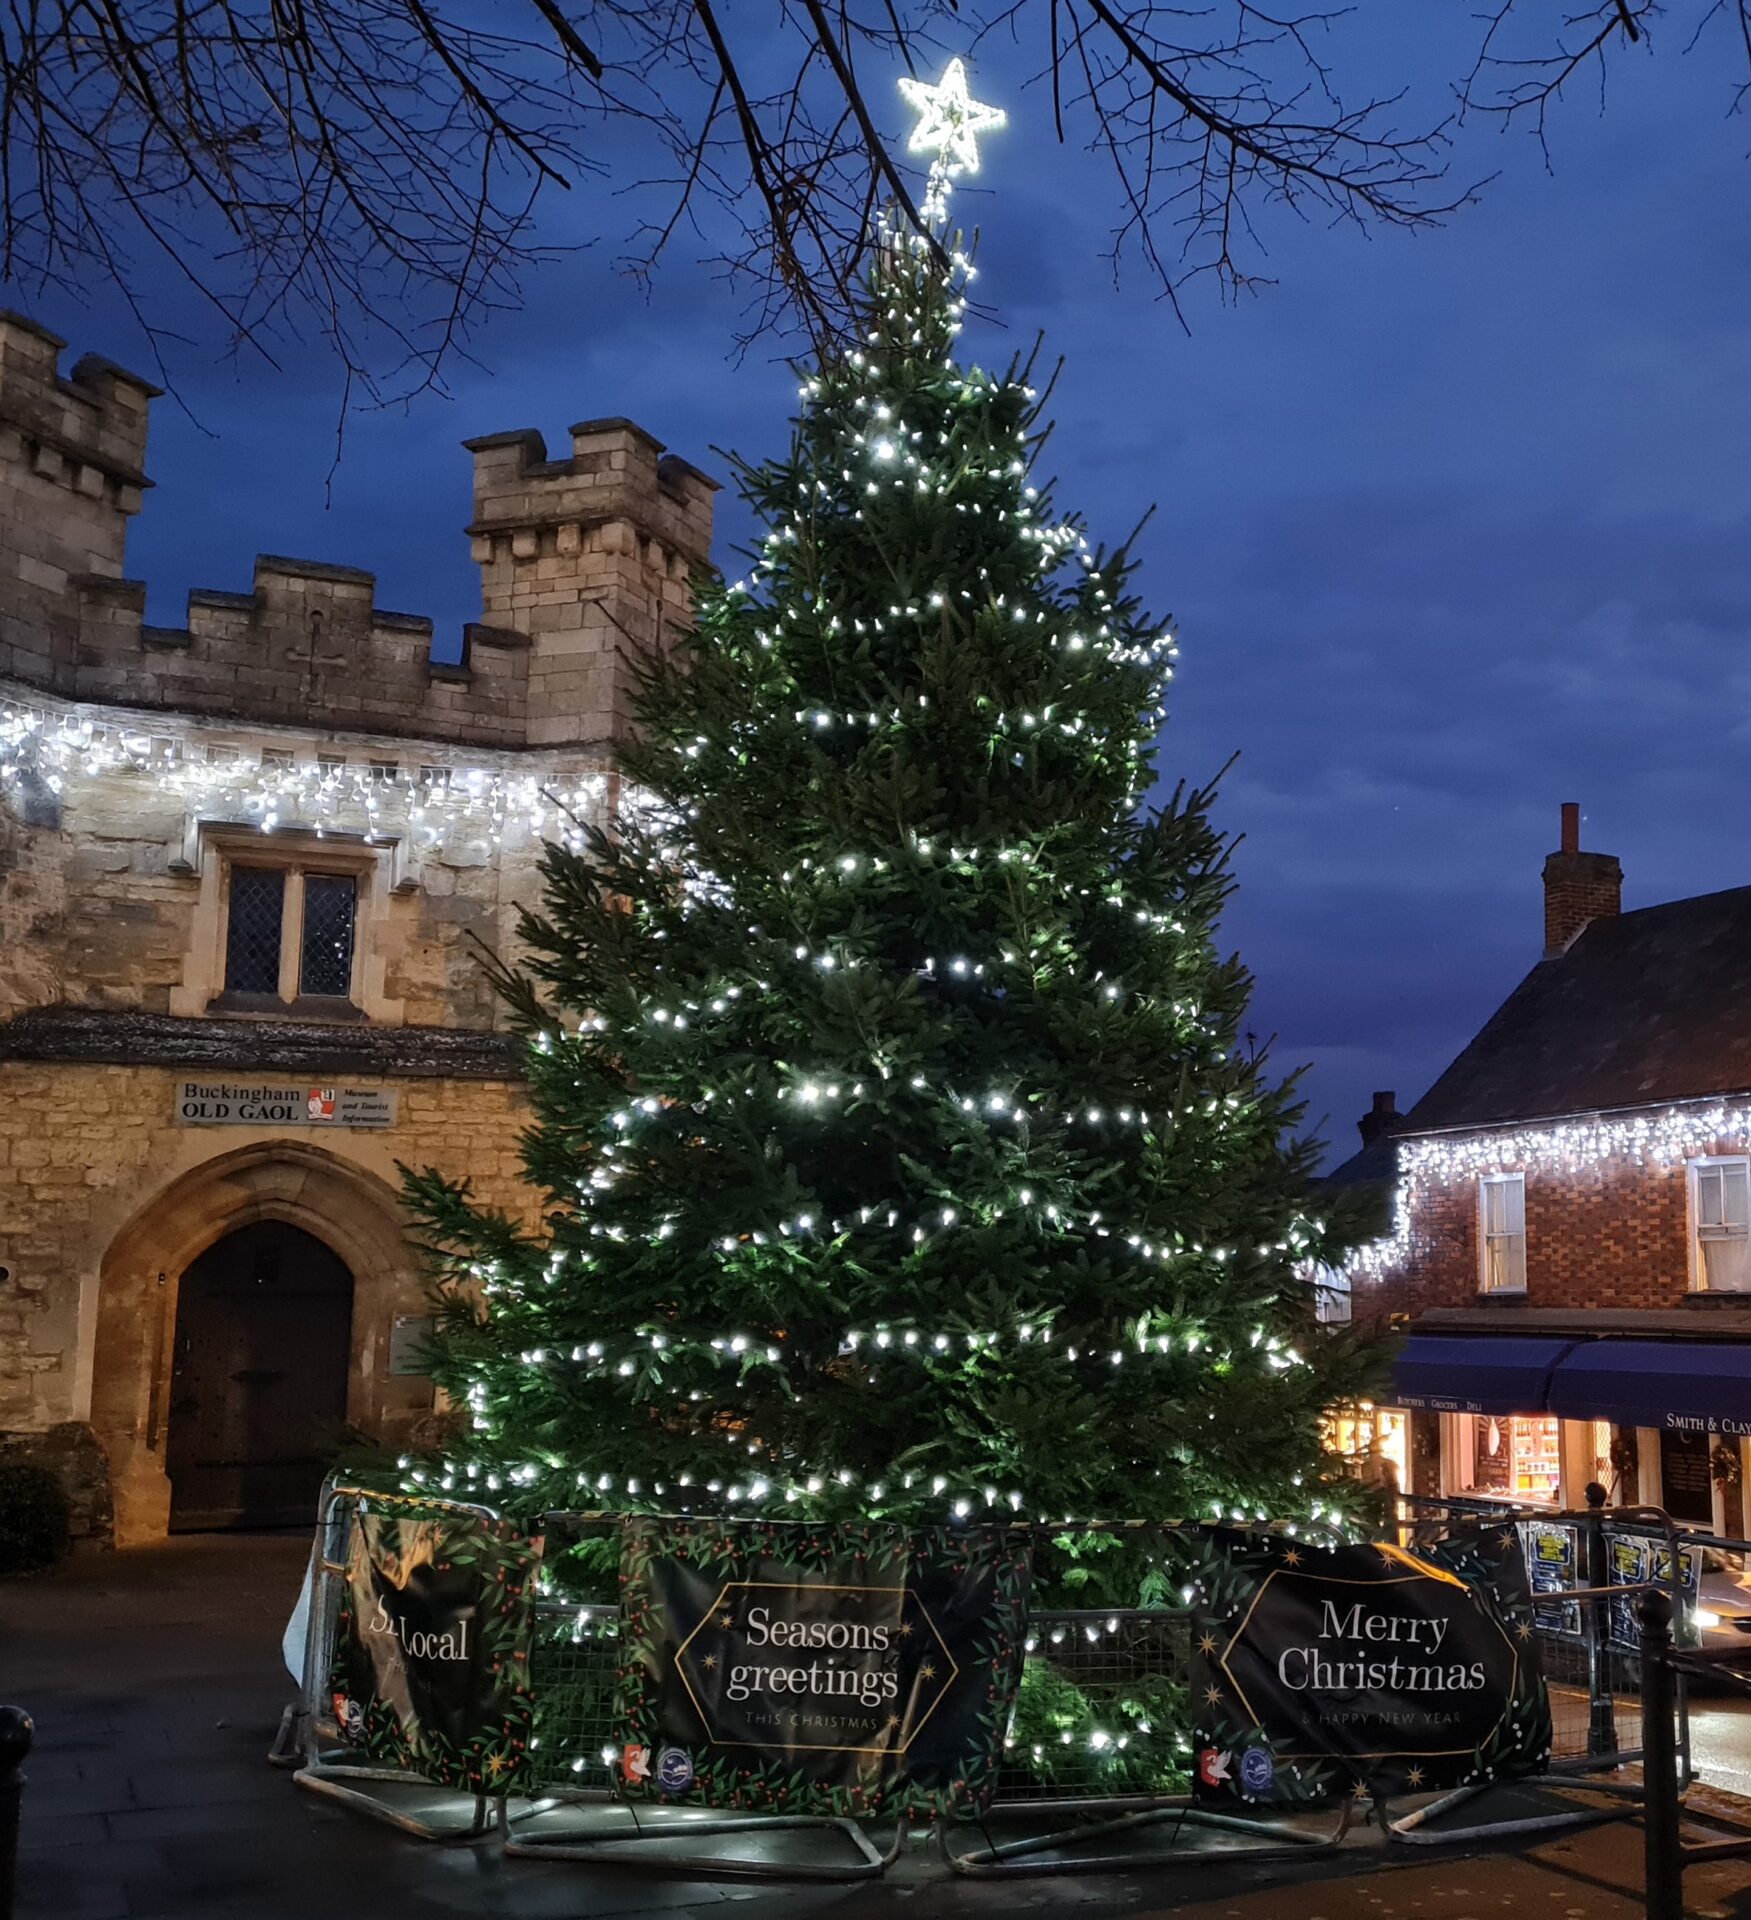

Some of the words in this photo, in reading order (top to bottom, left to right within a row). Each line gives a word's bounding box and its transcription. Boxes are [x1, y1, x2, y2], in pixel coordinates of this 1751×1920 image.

[184, 1083, 300, 1104] Buckingham
[182, 1103, 230, 1118] OLD
[238, 1104, 299, 1121] GAOL
[1666, 1413, 1704, 1431] SMITH
[1707, 1417, 1718, 1431] &
[746, 1607, 889, 1651] Seasons
[1318, 1600, 1449, 1654] Merry
[1278, 1647, 1486, 1691] Christmas
[726, 1659, 898, 1706] greetings
[745, 1711, 781, 1726] THIS
[789, 1713, 877, 1730] CHRISTMAS
[1319, 1711, 1370, 1725] HAPPY
[1379, 1711, 1415, 1725] NEW
[1423, 1711, 1461, 1725] YEAR
